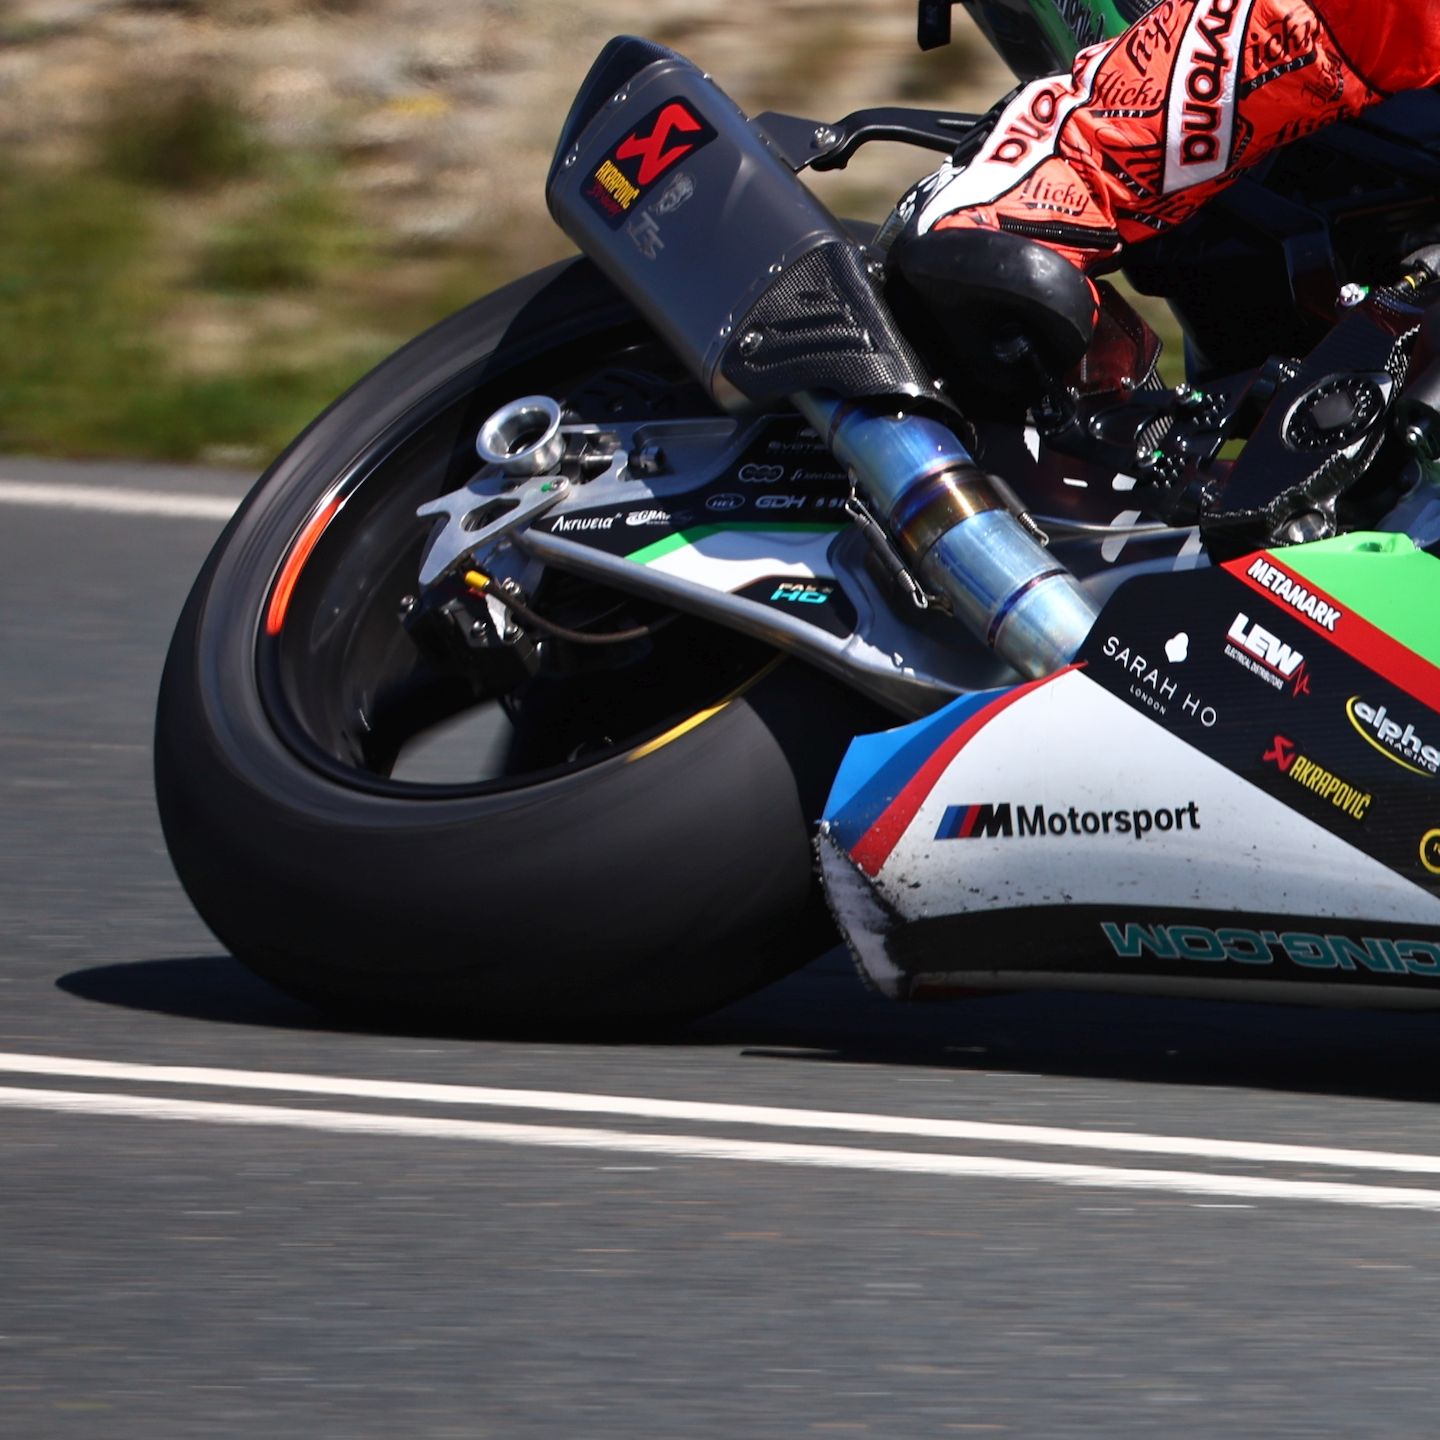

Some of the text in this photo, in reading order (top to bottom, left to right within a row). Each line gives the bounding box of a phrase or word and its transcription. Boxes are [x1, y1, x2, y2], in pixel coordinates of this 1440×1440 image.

[1250, 55, 1308, 90] SIXTY
[1246, 557, 1342, 631] METAMARK
[1227, 611, 1305, 678] LEW
[1102, 635, 1217, 728] SARAH HO
[1130, 684, 1167, 716] LONDON
[1383, 736, 1438, 774] RACING
[1289, 755, 1371, 821] AKRAPOVIČ
[1016, 800, 1201, 839] Motorsport
